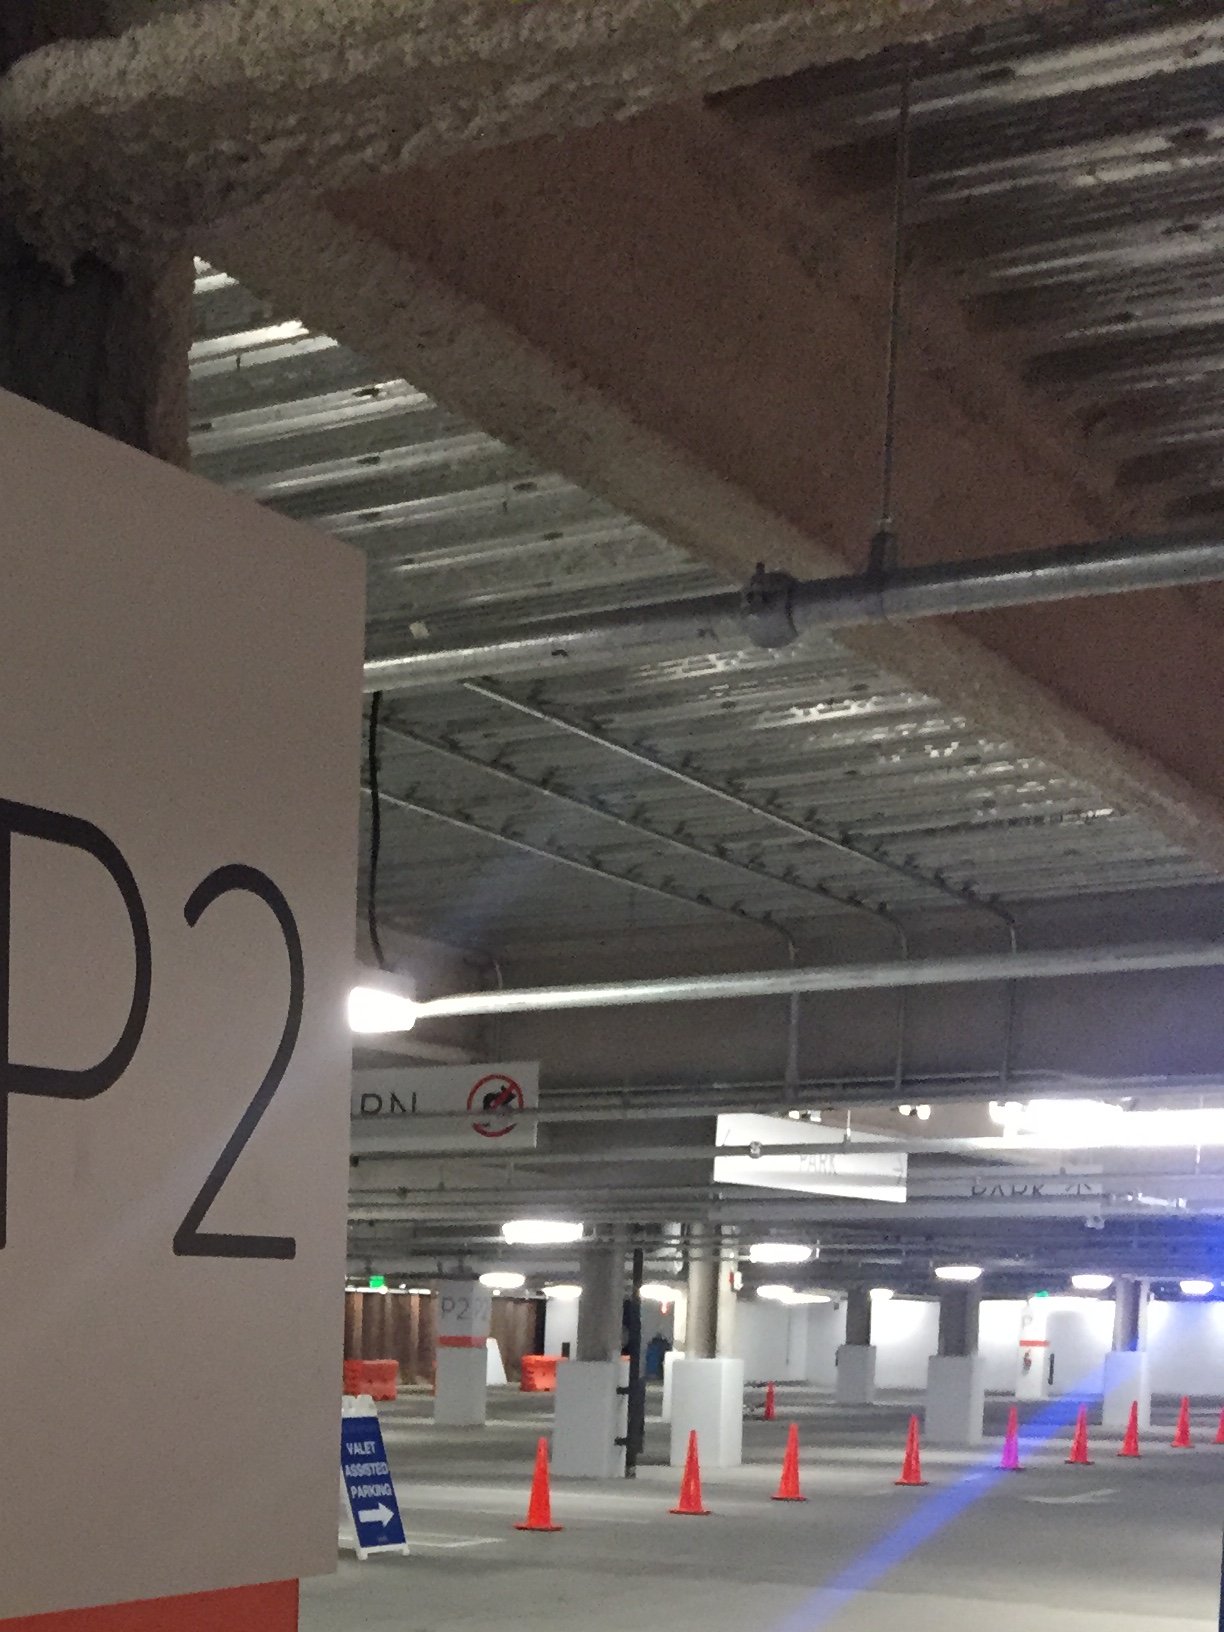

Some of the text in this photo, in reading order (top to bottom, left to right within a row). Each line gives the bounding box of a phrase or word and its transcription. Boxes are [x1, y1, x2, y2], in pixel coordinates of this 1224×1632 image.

[441, 1296, 473, 1320] P2
[346, 1441, 376, 1456] VALET
[345, 1462, 388, 1477] ASSISTED
[350, 1483, 393, 1498] PARKING
